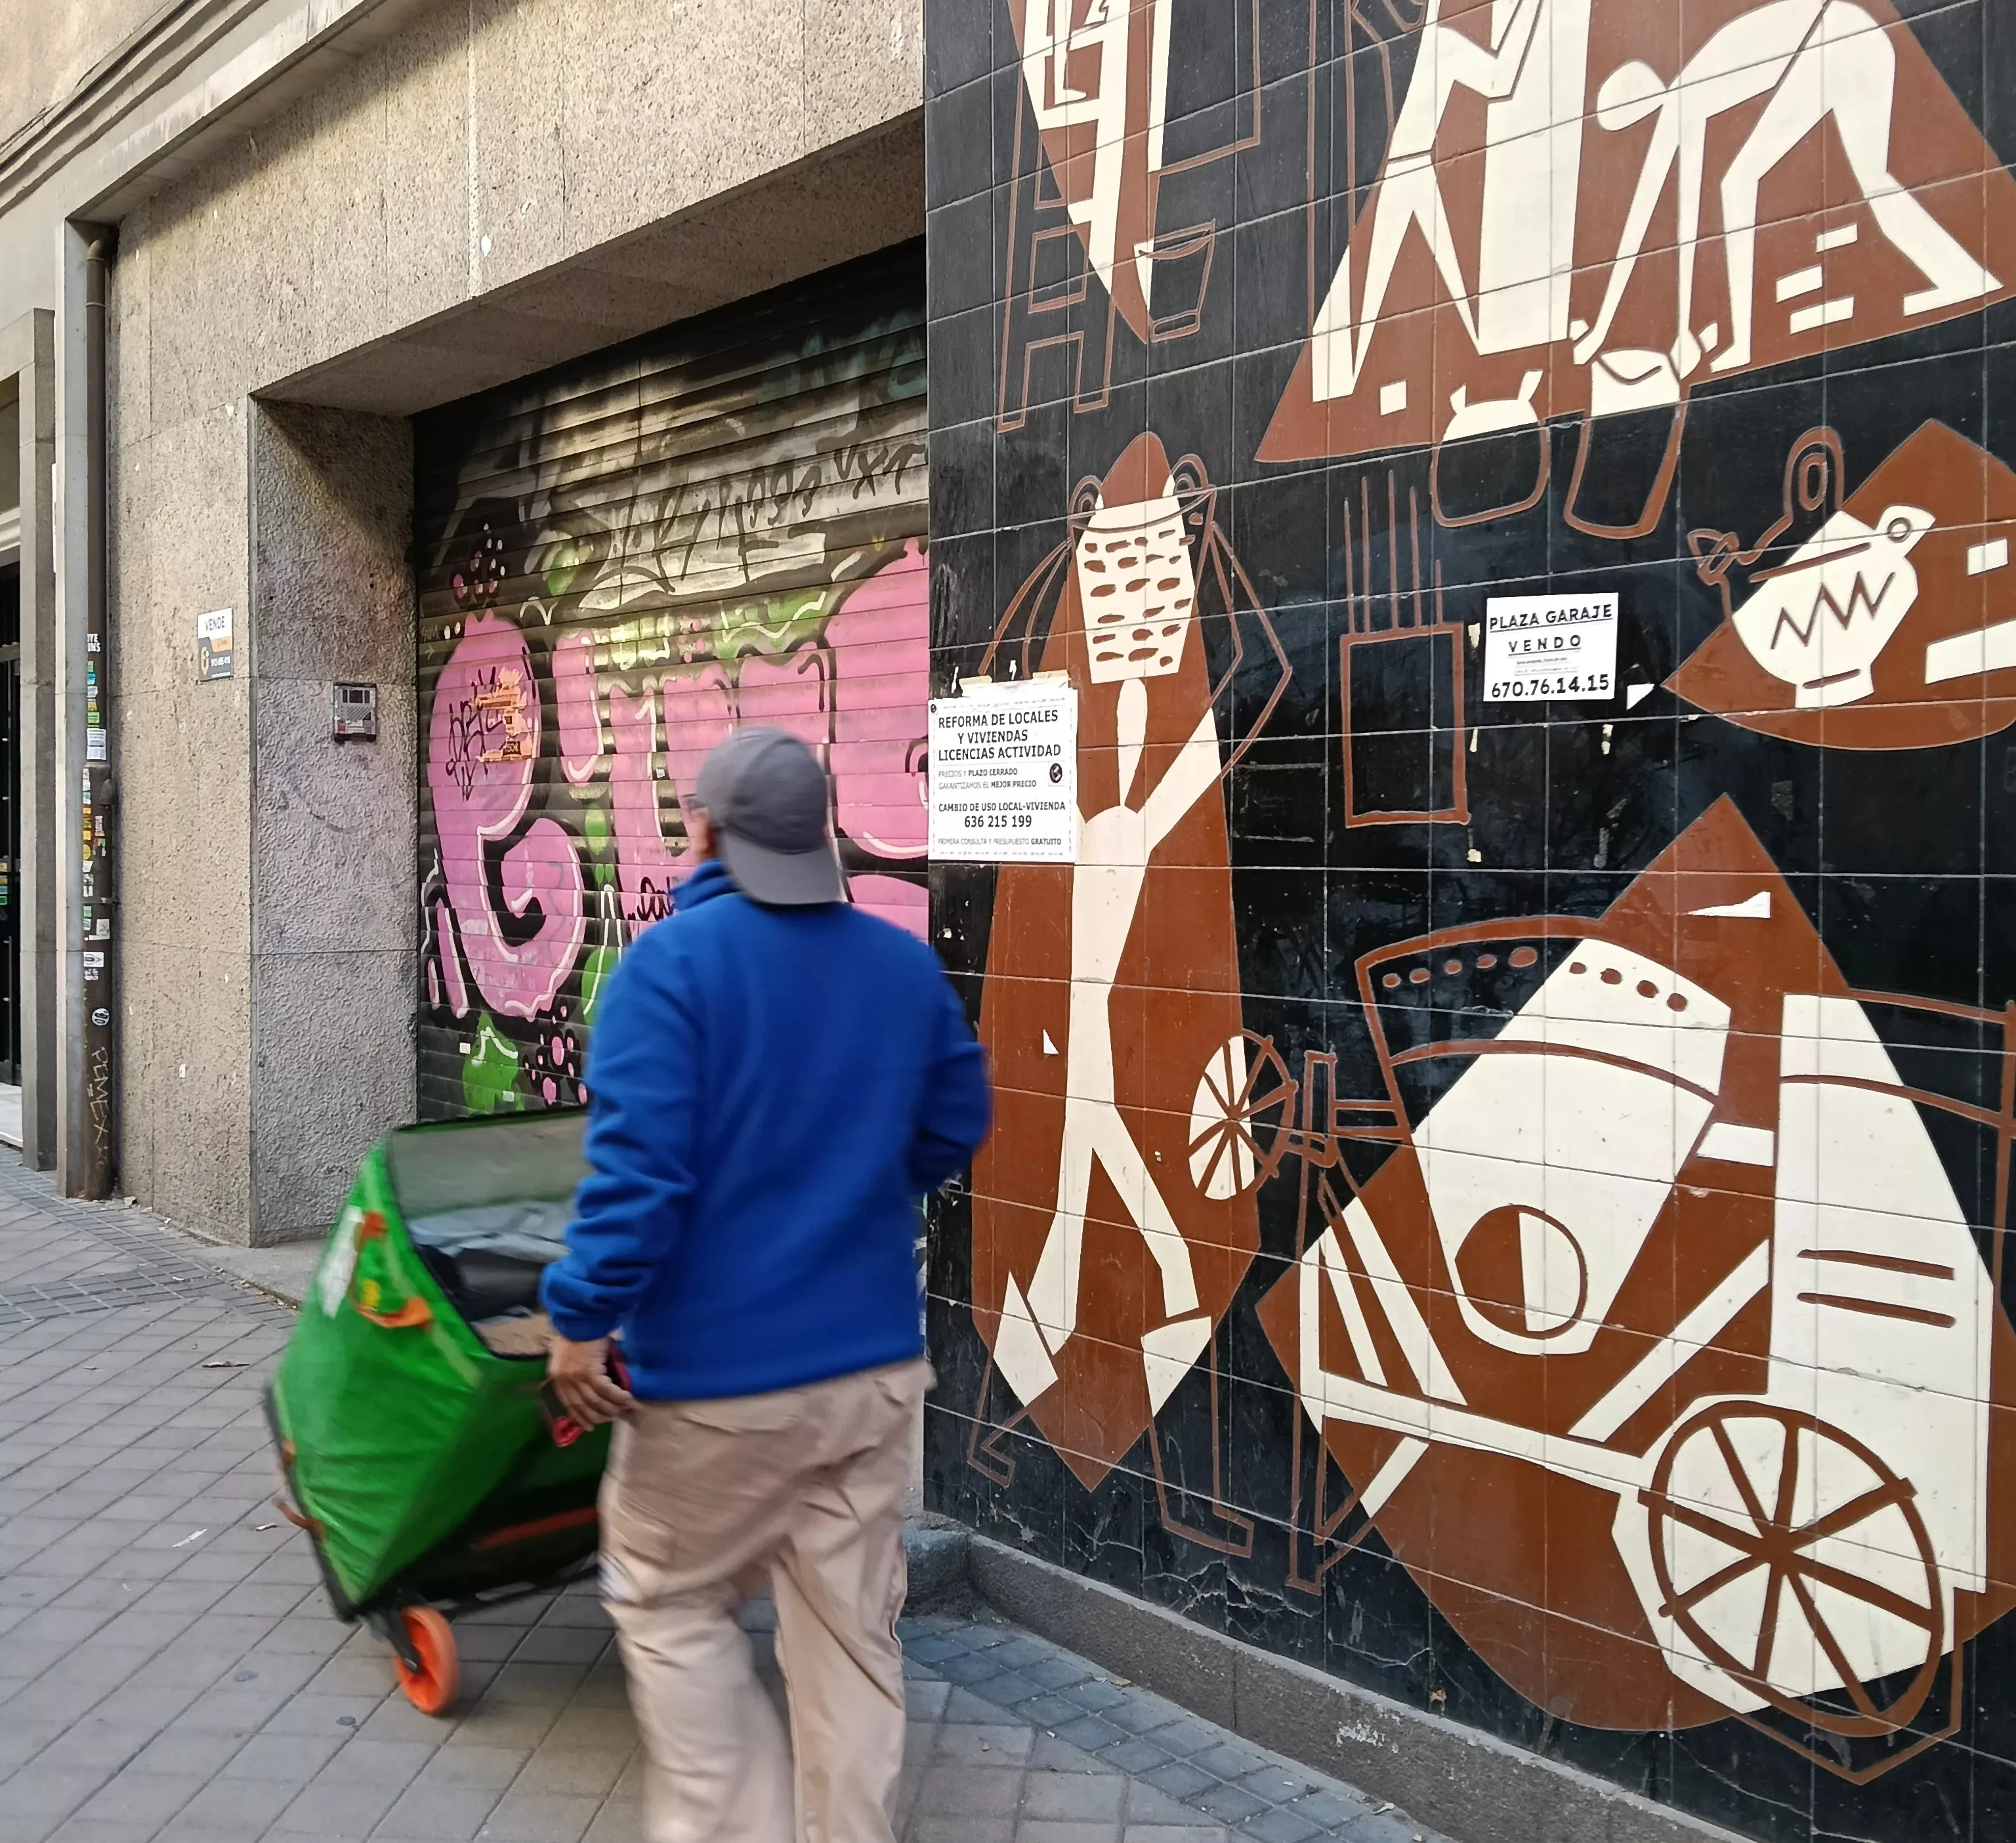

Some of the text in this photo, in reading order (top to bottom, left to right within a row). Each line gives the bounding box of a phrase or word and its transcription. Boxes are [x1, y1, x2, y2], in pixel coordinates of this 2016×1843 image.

[1490, 604, 1612, 630] PLAZA GARAJE
[1509, 634, 1581, 652] VENDO
[1492, 674, 1609, 698] 670.76.14.15
[938, 710, 1058, 728] REFORMA DE LOCALES
[957, 730, 1028, 744] Y VIVIENDAS
[938, 744, 1060, 761] LICENCIAS ACTIVIDAD
[938, 803, 967, 812] CAMBIO
[998, 801, 1065, 811] LOCAL-VIVIENDA
[964, 815, 1032, 827] 636 215 199
